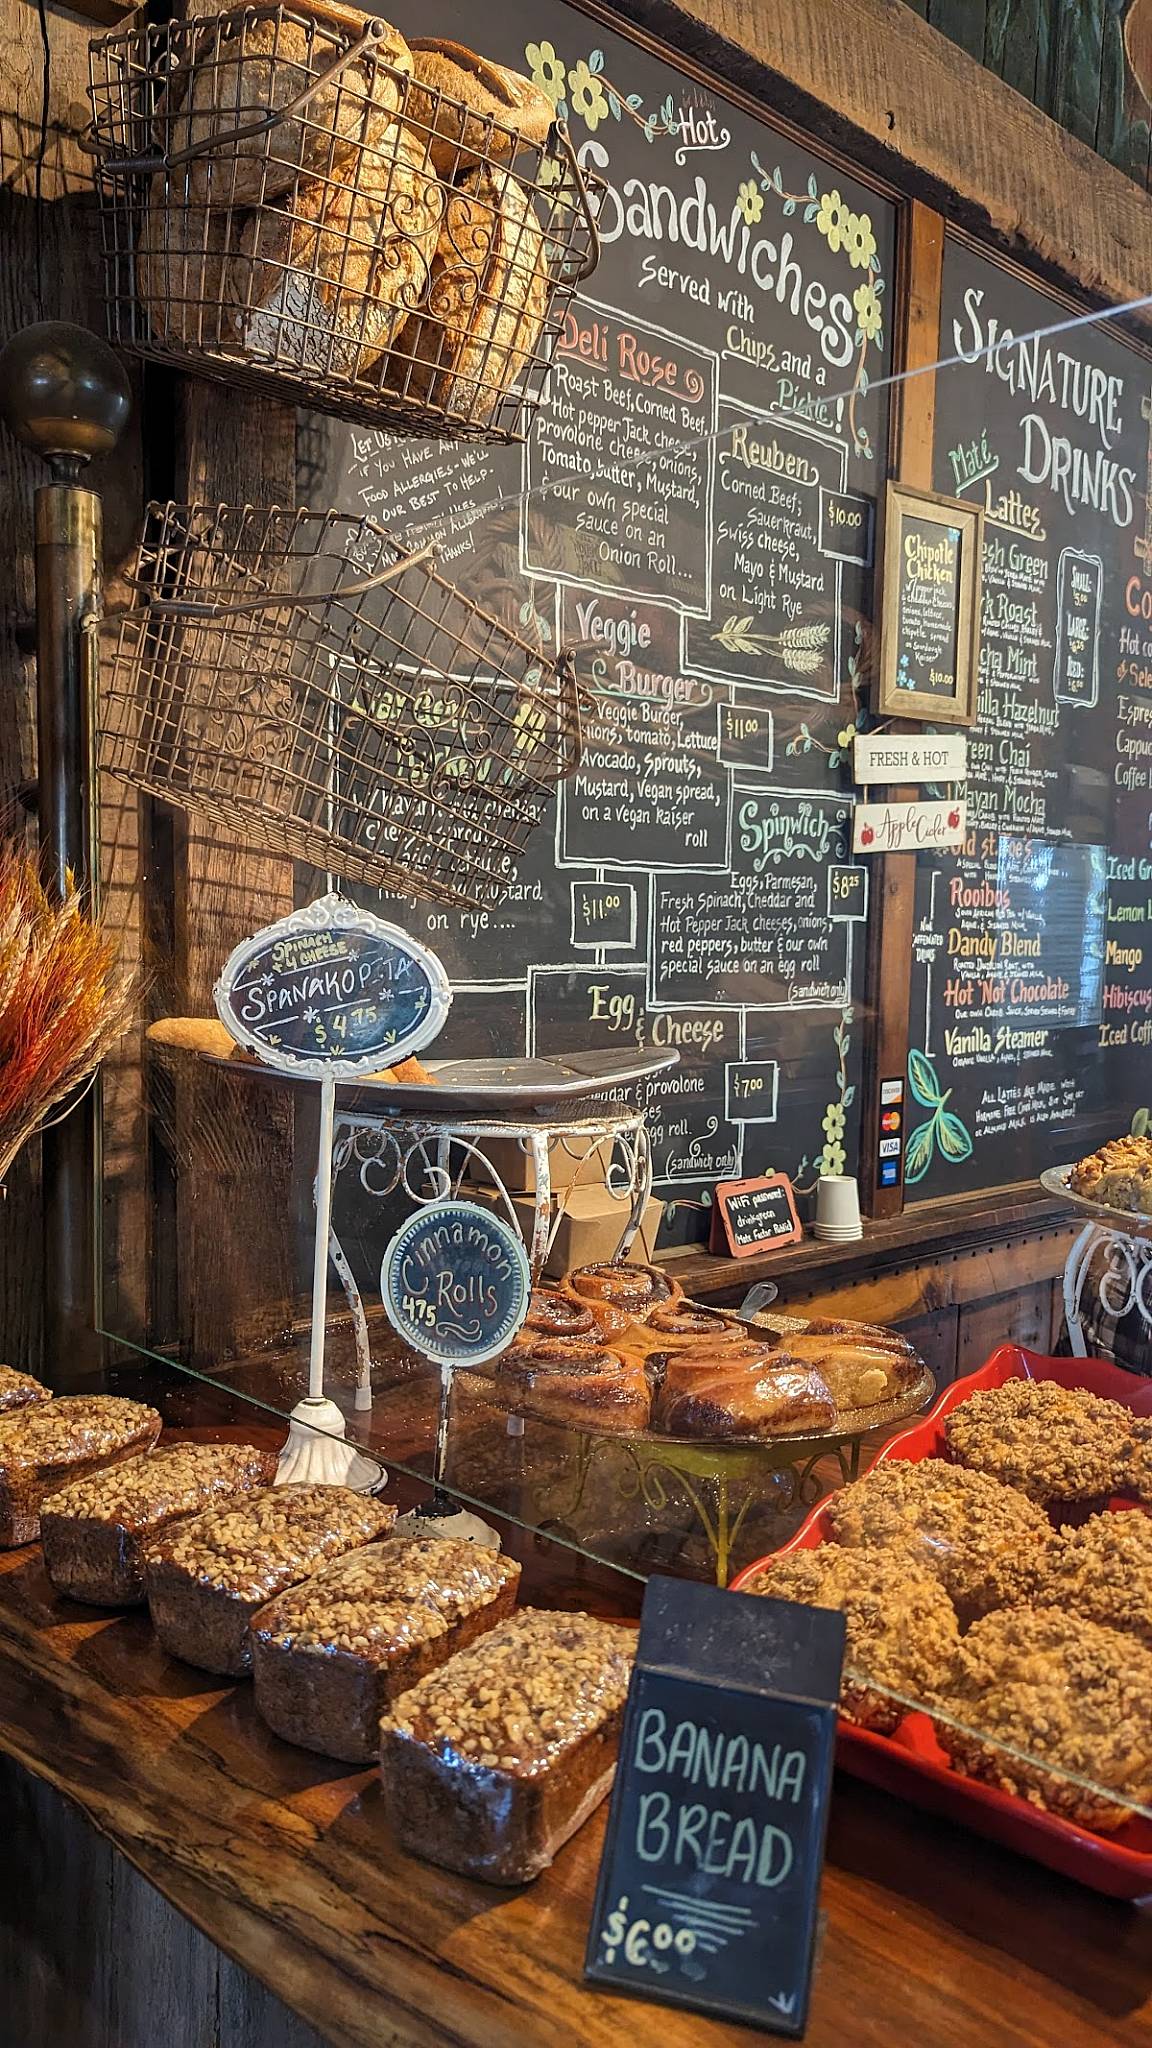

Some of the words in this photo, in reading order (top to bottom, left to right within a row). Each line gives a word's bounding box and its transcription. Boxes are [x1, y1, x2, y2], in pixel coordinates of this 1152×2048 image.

[677, 106, 719, 146] Hot
[577, 140, 854, 367] Sandwiches
[638, 256, 710, 306] Served
[717, 291, 754, 323] with
[554, 310, 608, 361] Deli
[617, 332, 678, 386] Rose
[726, 325, 775, 369] Chips
[781, 351, 811, 379] and
[816, 366, 826, 385] a
[953, 288, 1124, 450] SIGNATURE
[553, 363, 600, 397] Roast
[680, 407, 709, 436] Beef,
[552, 395, 576, 420] Hot
[578, 409, 622, 436] pepper
[622, 417, 652, 445] Jack
[732, 425, 810, 481] Reuben
[948, 427, 992, 487] Maté
[659, 456, 702, 487] onions,
[721, 469, 766, 502] Corned
[1016, 413, 1137, 528] DRINKS
[553, 485, 581, 501] our
[587, 491, 616, 512] own
[622, 501, 669, 525] special
[646, 473, 701, 509] Mustard,
[984, 479, 1041, 531] Lattes
[576, 512, 619, 535] sauce
[625, 524, 643, 542] on
[648, 530, 665, 548] an
[747, 508, 817, 545] Sauerkraut,
[828, 499, 862, 528] $10.00
[599, 541, 641, 569] Onion
[717, 521, 754, 550] Swiss
[757, 531, 800, 562] cheese,
[904, 534, 954, 567] Chipotle
[733, 552, 764, 583] Mayo
[778, 563, 824, 592] Mustard
[906, 556, 953, 585] Chicken
[1009, 543, 1048, 580] Green
[719, 583, 736, 600] on
[742, 585, 776, 614] Light
[782, 594, 803, 623] Rye
[996, 593, 1038, 628] Roast
[575, 599, 651, 656] Veggie
[1119, 625, 1139, 656] Hot
[1006, 645, 1038, 678] Mint
[611, 660, 697, 710] Burger
[597, 701, 638, 728] Veggie
[640, 701, 684, 732] Burger,
[1002, 691, 1060, 728] Hazelnut
[626, 726, 676, 750] tomato,
[677, 730, 719, 750] Lettuce
[1000, 739, 1031, 768] Chai
[579, 748, 641, 775] Avocado,
[870, 752, 908, 767] FRESH
[911, 752, 920, 766] &
[923, 751, 949, 766] HOT
[574, 775, 634, 803] Mustard,
[675, 783, 721, 807] spread,
[1114, 762, 1147, 791] Coffee
[582, 805, 599, 821] on
[603, 806, 612, 822] a
[1003, 785, 1046, 816] Mocha
[685, 829, 708, 848] roll
[738, 800, 832, 857] Spinwich
[876, 806, 917, 849] Apple
[915, 813, 947, 843] Cider
[730, 871, 764, 896] Eggs,
[765, 873, 818, 894] Parmesan,
[1106, 856, 1136, 881] Iced
[660, 891, 694, 915] Fresh
[696, 890, 746, 918] Spinach,
[748, 893, 790, 909] Cheddar
[795, 892, 816, 909] and
[950, 877, 1011, 909] Rooibos
[427, 913, 449, 930] on
[660, 914, 681, 934] Hot
[685, 916, 723, 937] Pepper
[724, 915, 749, 934] Jack
[752, 914, 797, 936] cheeses,
[1107, 897, 1145, 923] Lemon
[272, 932, 333, 962] SPINACH
[299, 941, 348, 965] CHEESE
[661, 936, 684, 953] red
[687, 938, 738, 959] peppers,
[740, 936, 773, 954] butter
[785, 940, 803, 953] our
[807, 938, 829, 952] own
[948, 927, 997, 960] Dandy
[1001, 930, 1041, 957] Blend
[1105, 939, 1142, 973] Mango
[660, 954, 703, 983] special
[705, 958, 740, 981] sauce
[743, 959, 758, 974] on
[760, 961, 774, 975] an
[778, 958, 796, 980] egg
[801, 955, 820, 972] roll
[943, 979, 975, 1006] Hot
[1010, 976, 1070, 1005] Chocolate
[587, 984, 635, 1031] Egg
[652, 1013, 724, 1052] Cheese
[945, 1026, 991, 1055] Vanilla
[994, 1026, 1049, 1054] Steamer
[1098, 1023, 1127, 1049] Iced
[646, 1074, 705, 1104] provolone
[882, 1142, 899, 1154] VISA
[727, 1195, 751, 1211] WiFi
[402, 1222, 512, 1295] Cinnamon
[436, 1271, 498, 1317] Rolls
[634, 1708, 806, 1803] BANANA
[636, 1791, 793, 1888] BREAD
